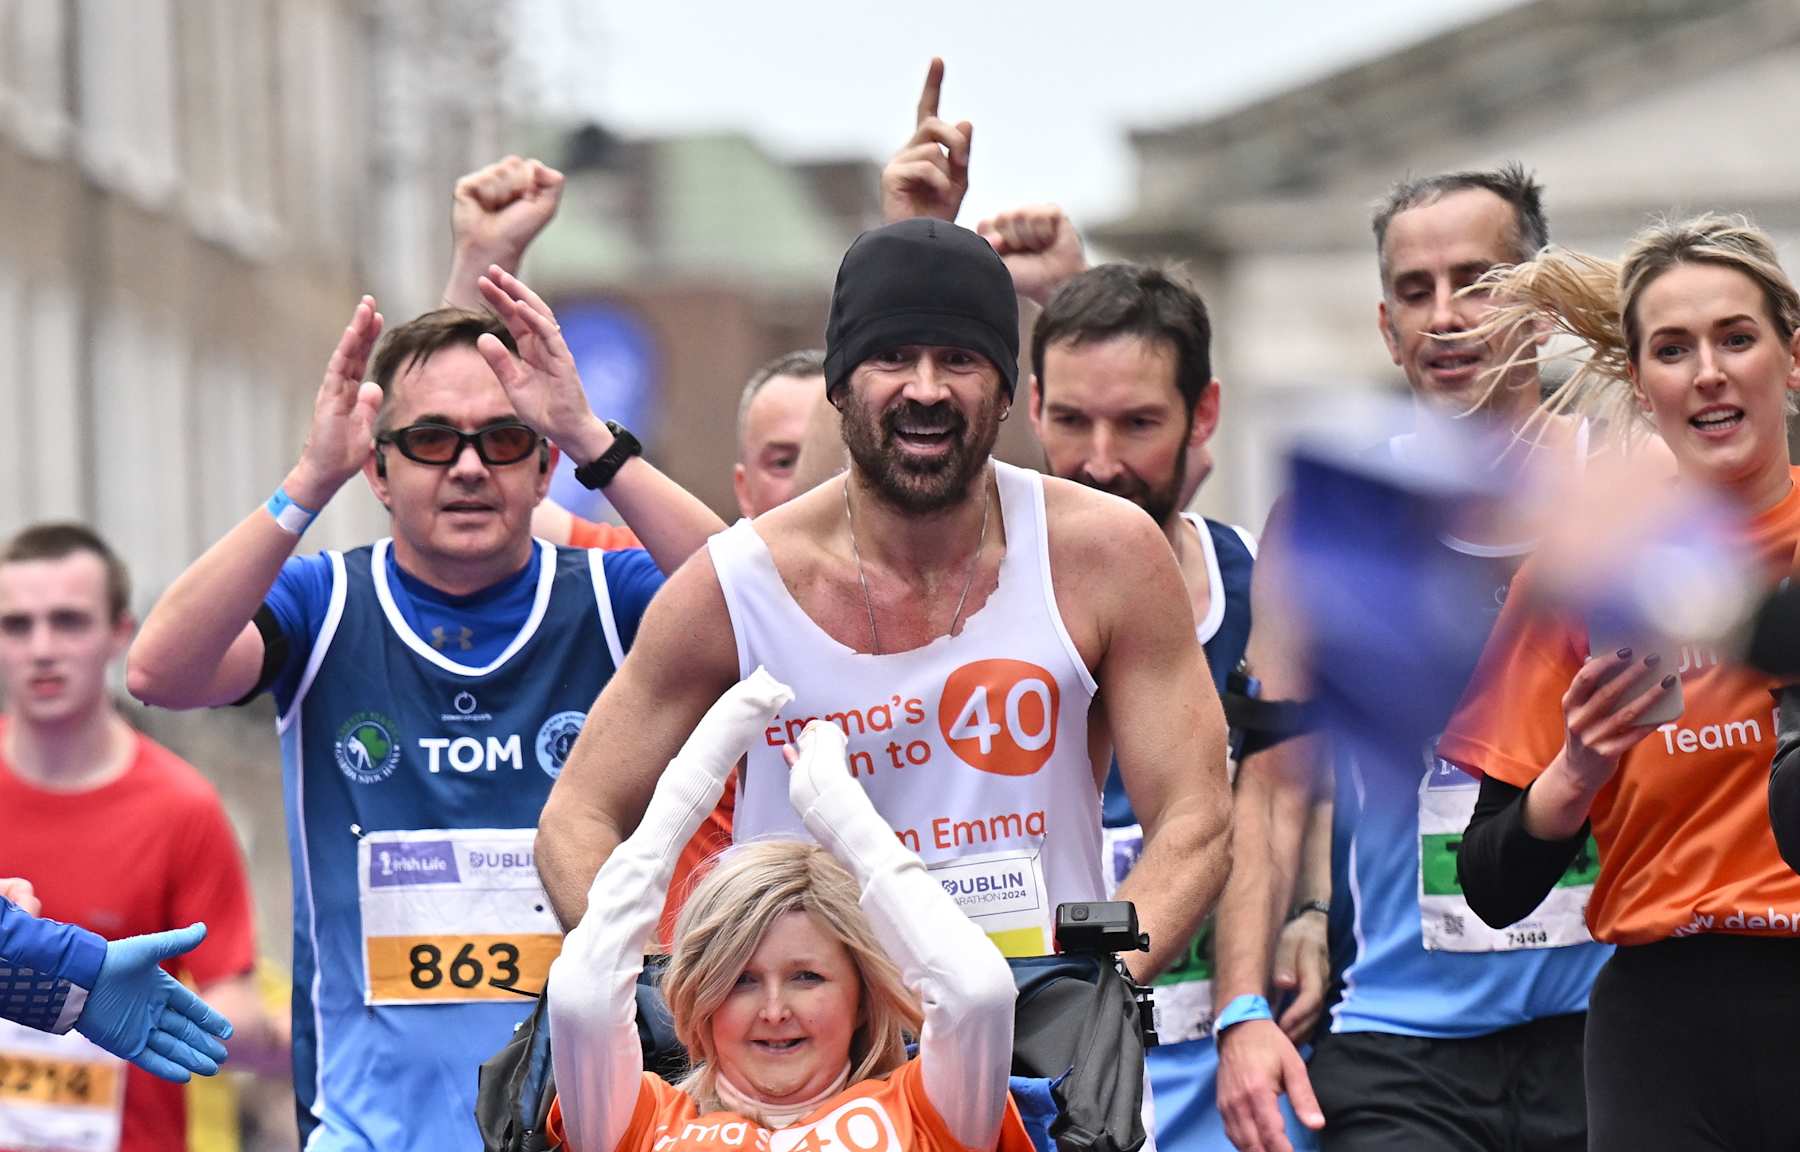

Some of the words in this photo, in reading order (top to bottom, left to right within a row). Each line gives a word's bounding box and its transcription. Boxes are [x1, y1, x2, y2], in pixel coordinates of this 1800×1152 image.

[948, 677, 1052, 755] 40
[1657, 719, 1761, 755] Team
[419, 734, 523, 773] TOM
[886, 740, 931, 769] to
[932, 811, 1045, 849] Emma
[392, 856, 420, 872] Irish
[422, 856, 447, 871] Life
[469, 852, 531, 868] DUBLI
[941, 872, 1023, 896] DUBLIN
[955, 893, 1001, 906] ARATHON
[1002, 890, 1026, 900] 2024
[409, 943, 520, 989] 863
